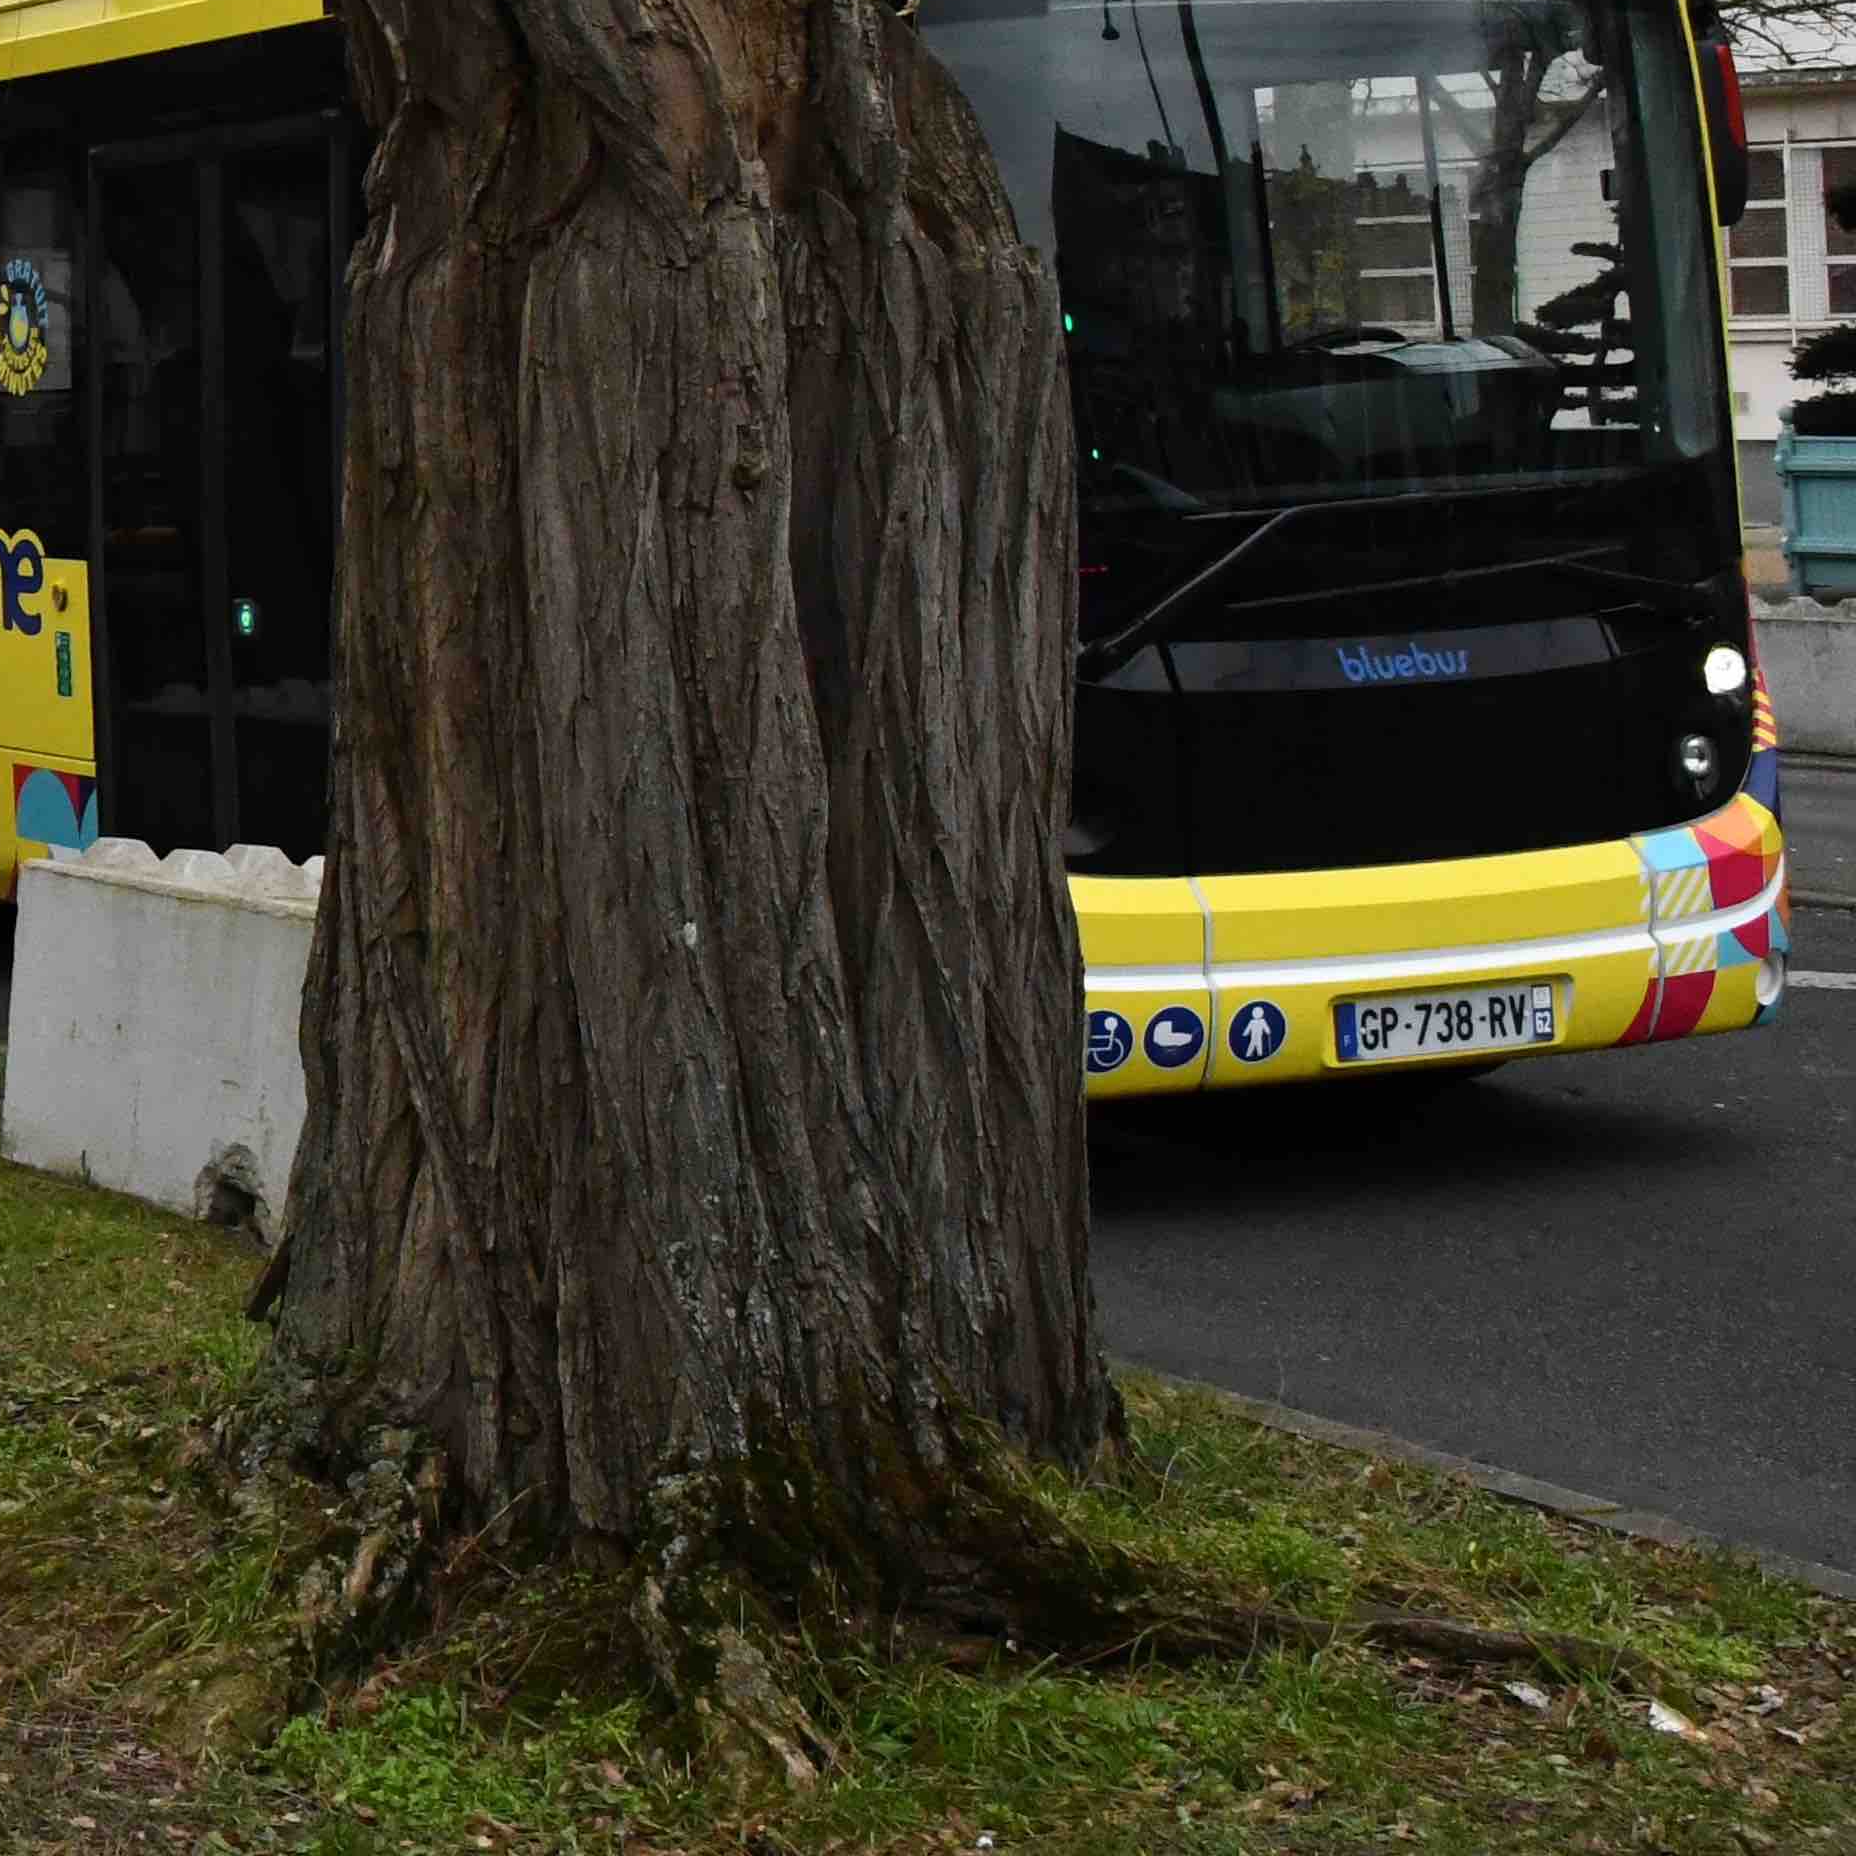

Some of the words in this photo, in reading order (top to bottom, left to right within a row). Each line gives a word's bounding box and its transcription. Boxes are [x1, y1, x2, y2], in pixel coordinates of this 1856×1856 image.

[1336, 641, 1468, 682] bluebus
[1360, 994, 1526, 1051] GP-738-RV
[1535, 1011, 1553, 1034] 62
